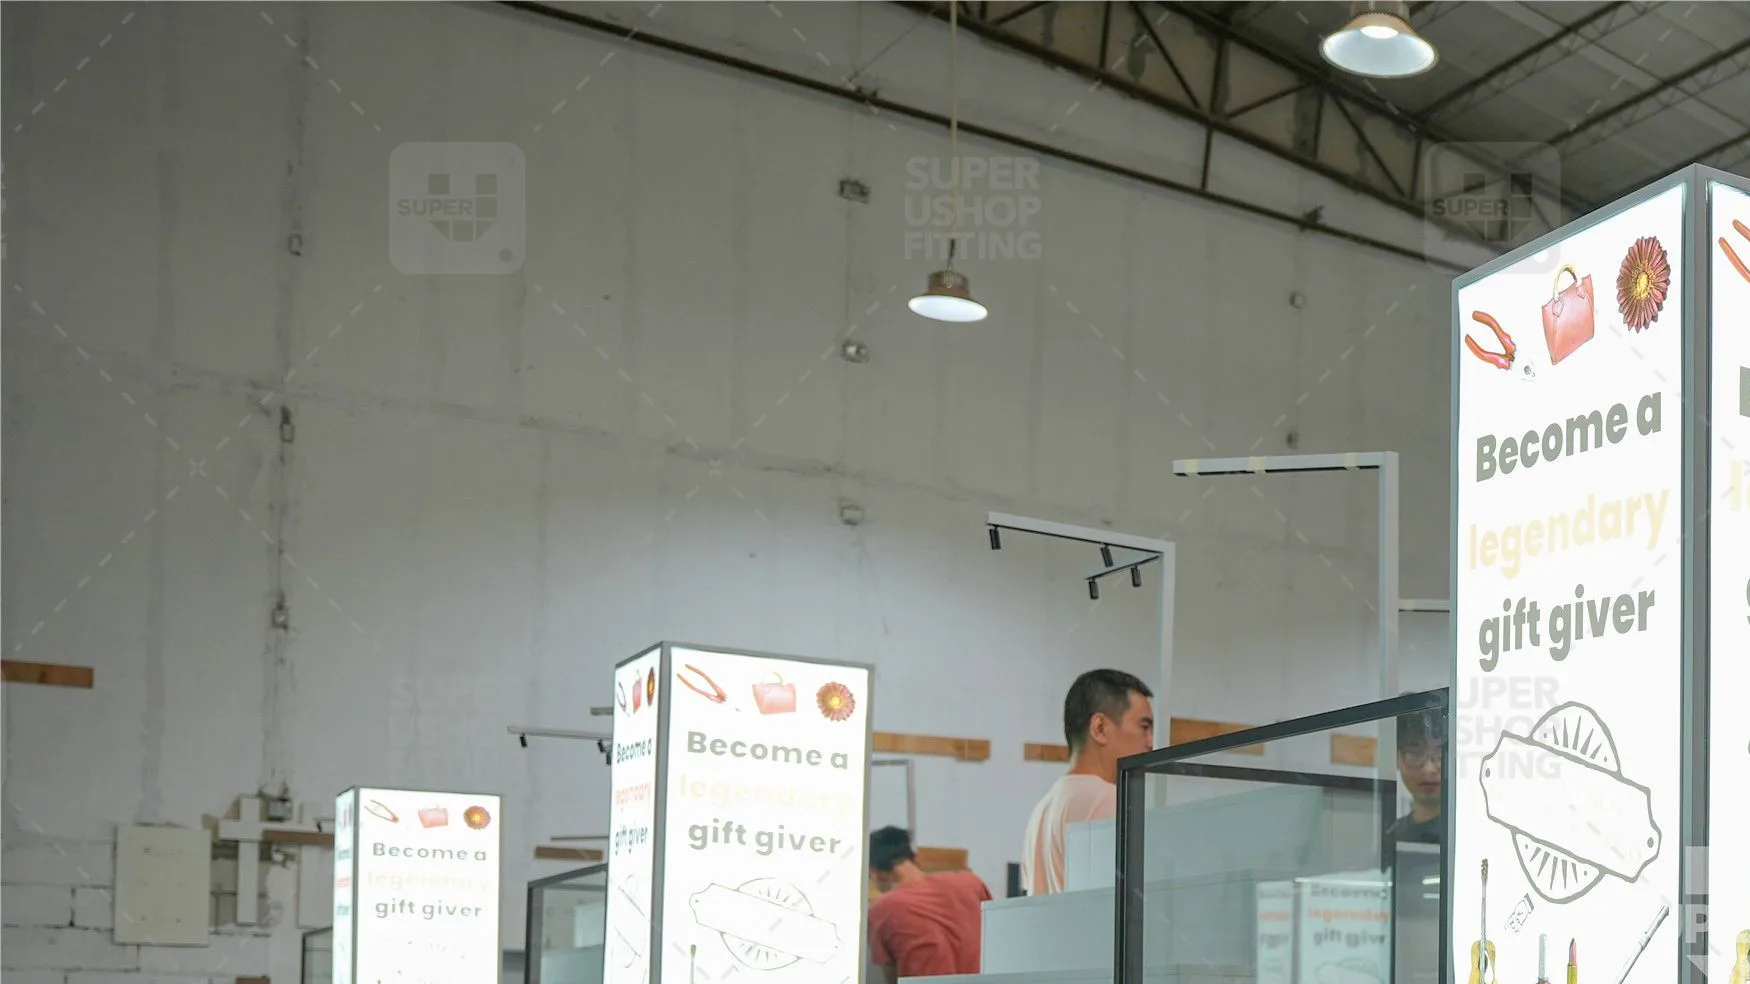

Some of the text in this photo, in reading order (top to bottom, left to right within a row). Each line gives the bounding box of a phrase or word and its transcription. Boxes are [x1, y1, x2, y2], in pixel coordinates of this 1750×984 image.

[1476, 391, 1661, 482] Become a
[1469, 489, 1669, 579] legendary
[1479, 584, 1655, 672] gift giver
[617, 740, 645, 763] Become
[687, 731, 848, 769] Become a
[373, 842, 487, 861] Become a
[688, 818, 841, 856] gift giver
[375, 897, 415, 918] gift
[422, 900, 482, 920] giver
